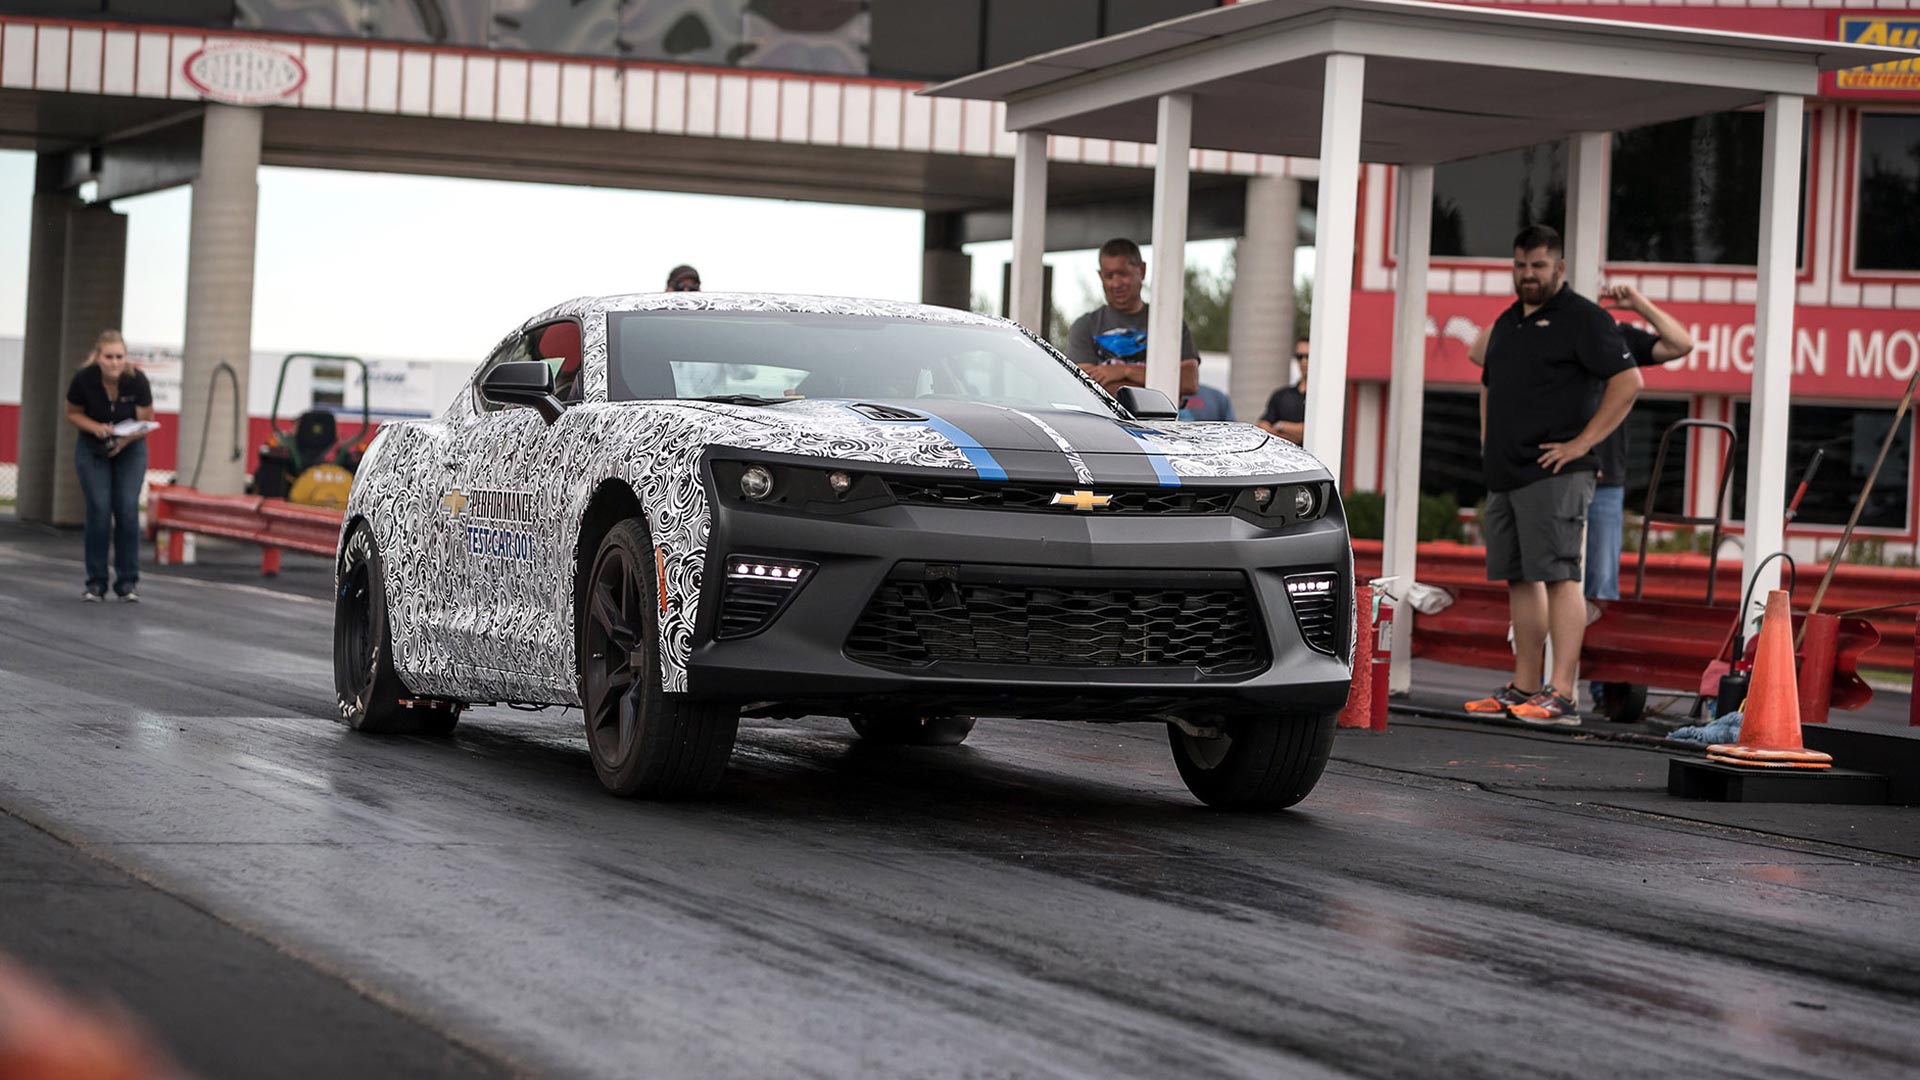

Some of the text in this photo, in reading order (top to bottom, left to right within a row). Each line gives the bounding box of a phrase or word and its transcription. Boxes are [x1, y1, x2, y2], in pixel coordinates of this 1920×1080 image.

[1854, 20, 1920, 49] Au
[1846, 329, 1920, 381] MO
[470, 489, 533, 522] PERFORMANCE
[467, 526, 533, 561] TEST CAR 001
